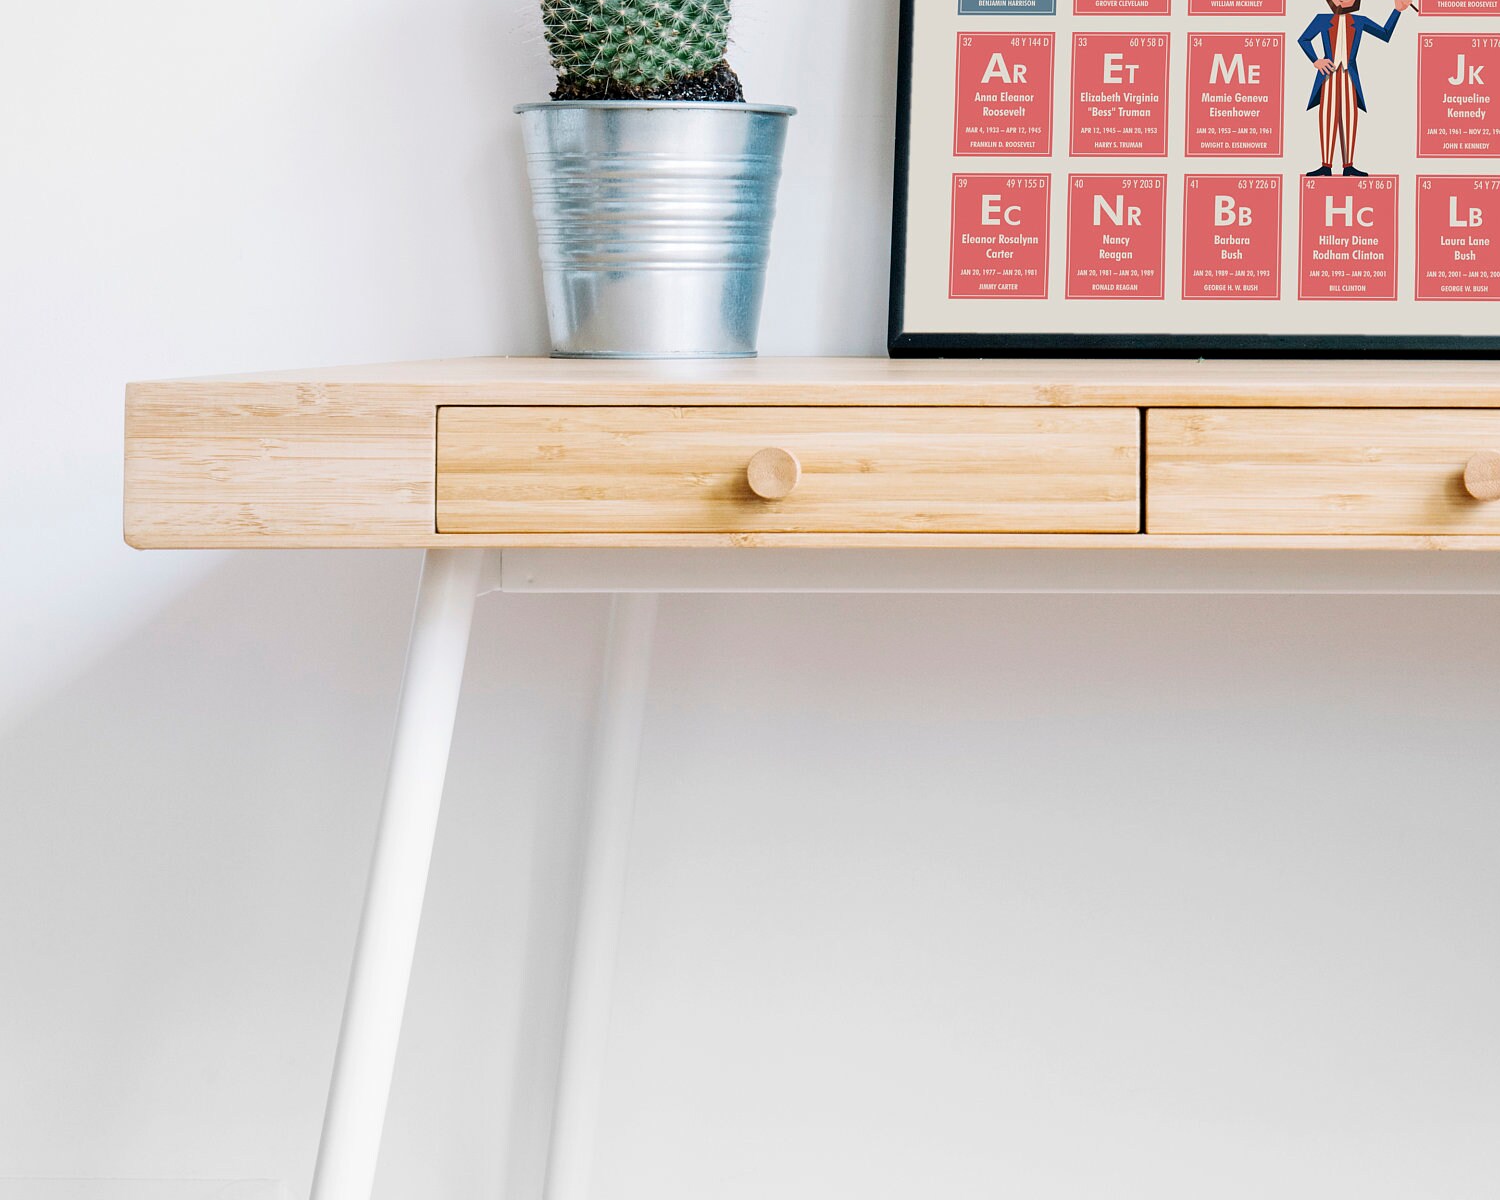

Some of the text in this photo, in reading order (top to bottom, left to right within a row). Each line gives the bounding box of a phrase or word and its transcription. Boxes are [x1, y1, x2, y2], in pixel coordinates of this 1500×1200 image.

[974, 92, 1034, 102] Anna Eleanor
[1442, 93, 1490, 105] Jacqueline
[983, 106, 1025, 116] Roosevelt
[1447, 108, 1486, 120] Kennedy
[1103, 235, 1130, 247] Nancy
[1214, 234, 1250, 245] Barbara
[1099, 249, 1132, 261] Reagan
[1221, 249, 1242, 259] Bush
